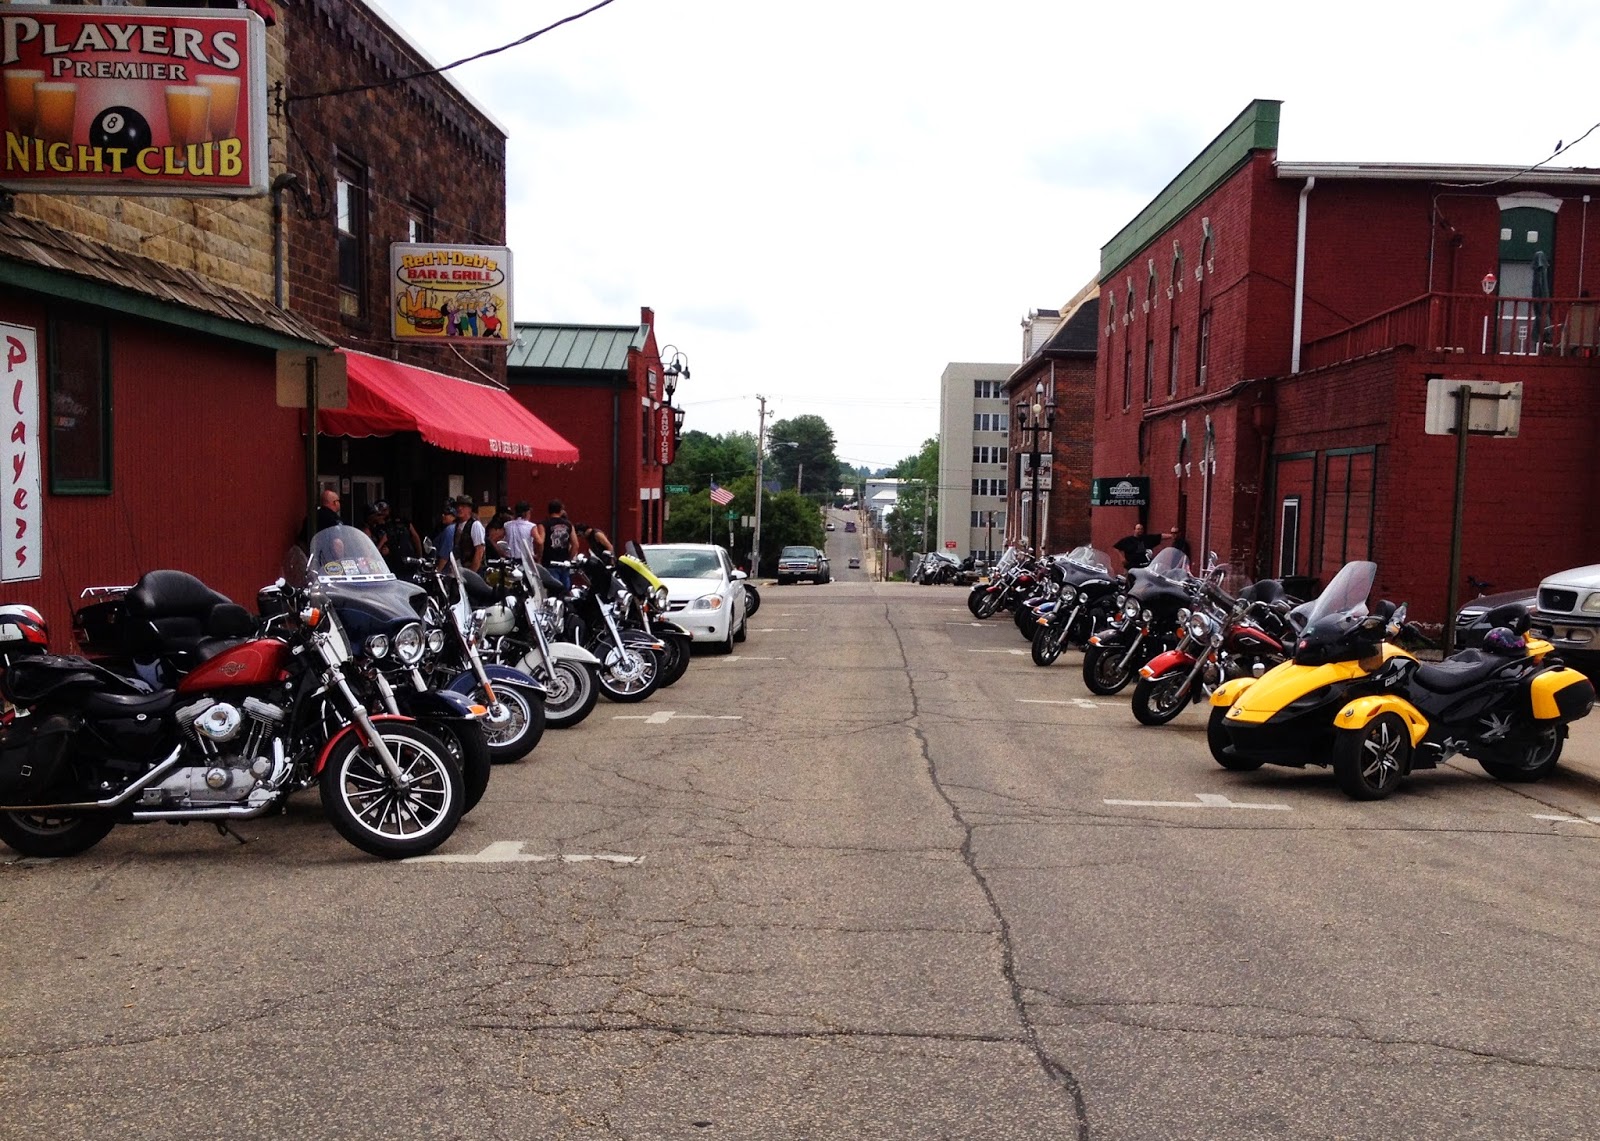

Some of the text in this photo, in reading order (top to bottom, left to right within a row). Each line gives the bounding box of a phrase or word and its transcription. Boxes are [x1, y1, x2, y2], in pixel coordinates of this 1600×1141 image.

[1, 16, 241, 70] PLAYERS
[51, 57, 188, 81] PREMIER
[107, 116, 118, 129] 8
[407, 269, 494, 282] BAR & GRILL
[660, 407, 670, 464] SANDWICHES
